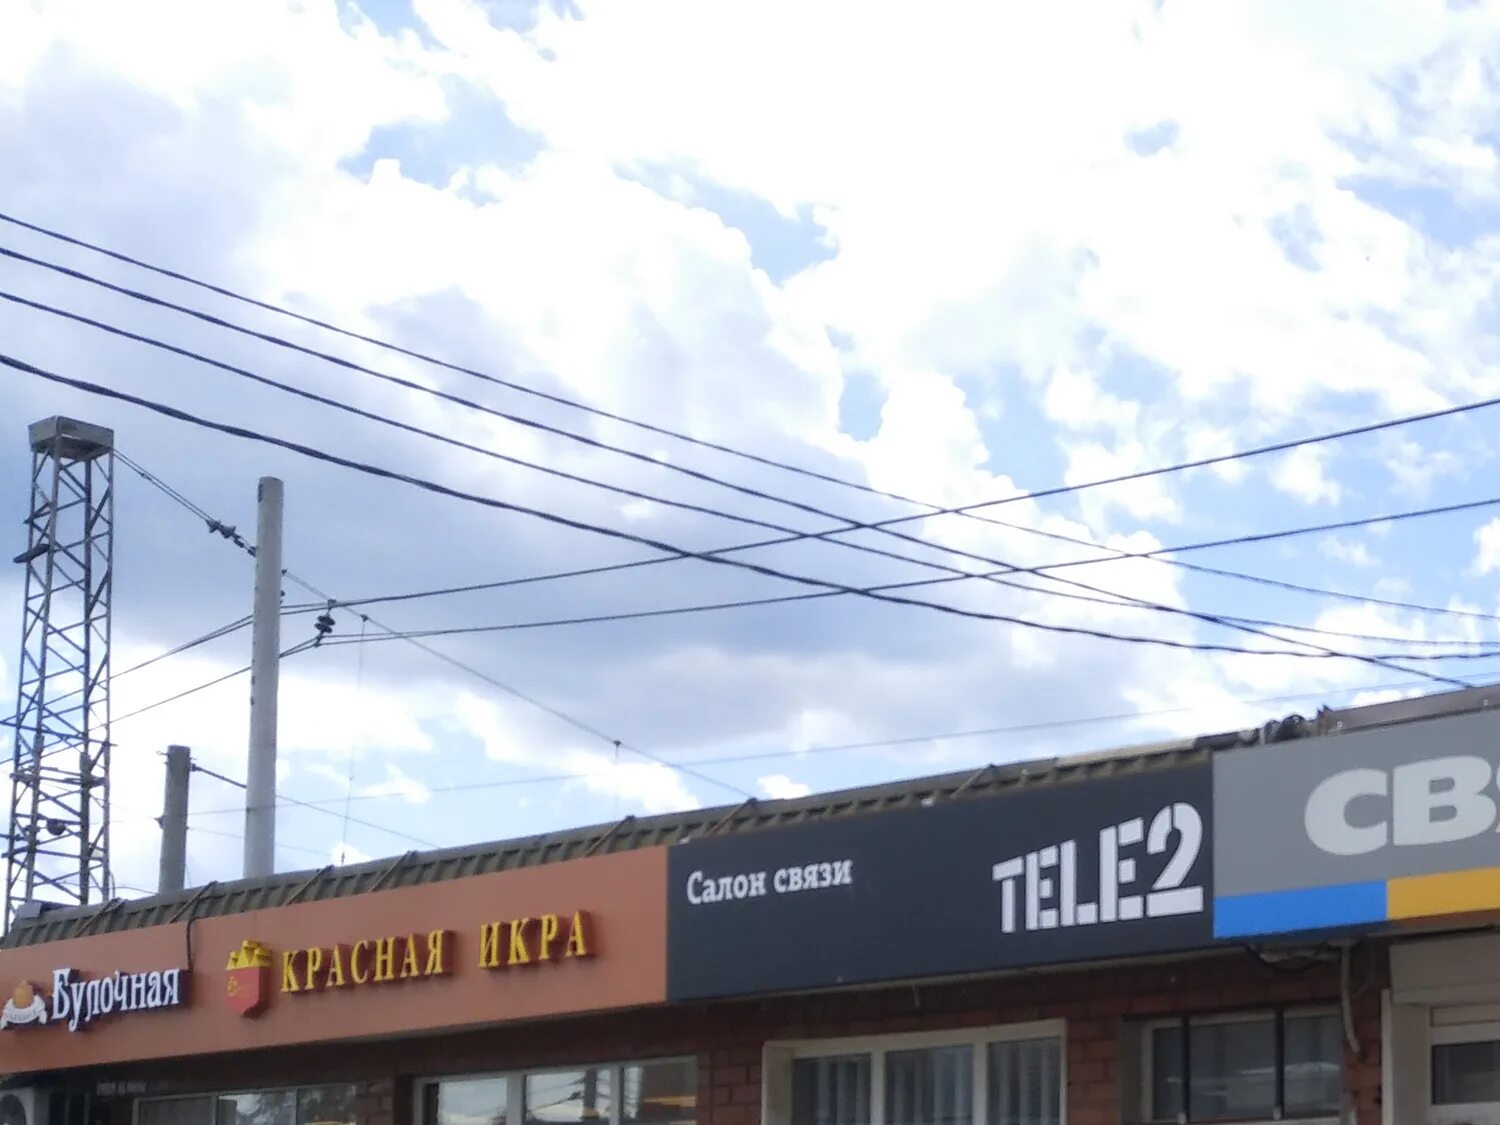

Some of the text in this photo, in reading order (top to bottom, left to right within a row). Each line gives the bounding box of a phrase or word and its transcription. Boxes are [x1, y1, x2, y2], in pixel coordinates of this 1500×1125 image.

[686, 858, 854, 905] Салон связи
[992, 802, 1204, 934] TELE2
[280, 909, 588, 994] КРАСНАЯ ИКРА
[51, 967, 182, 1033] Булочная
